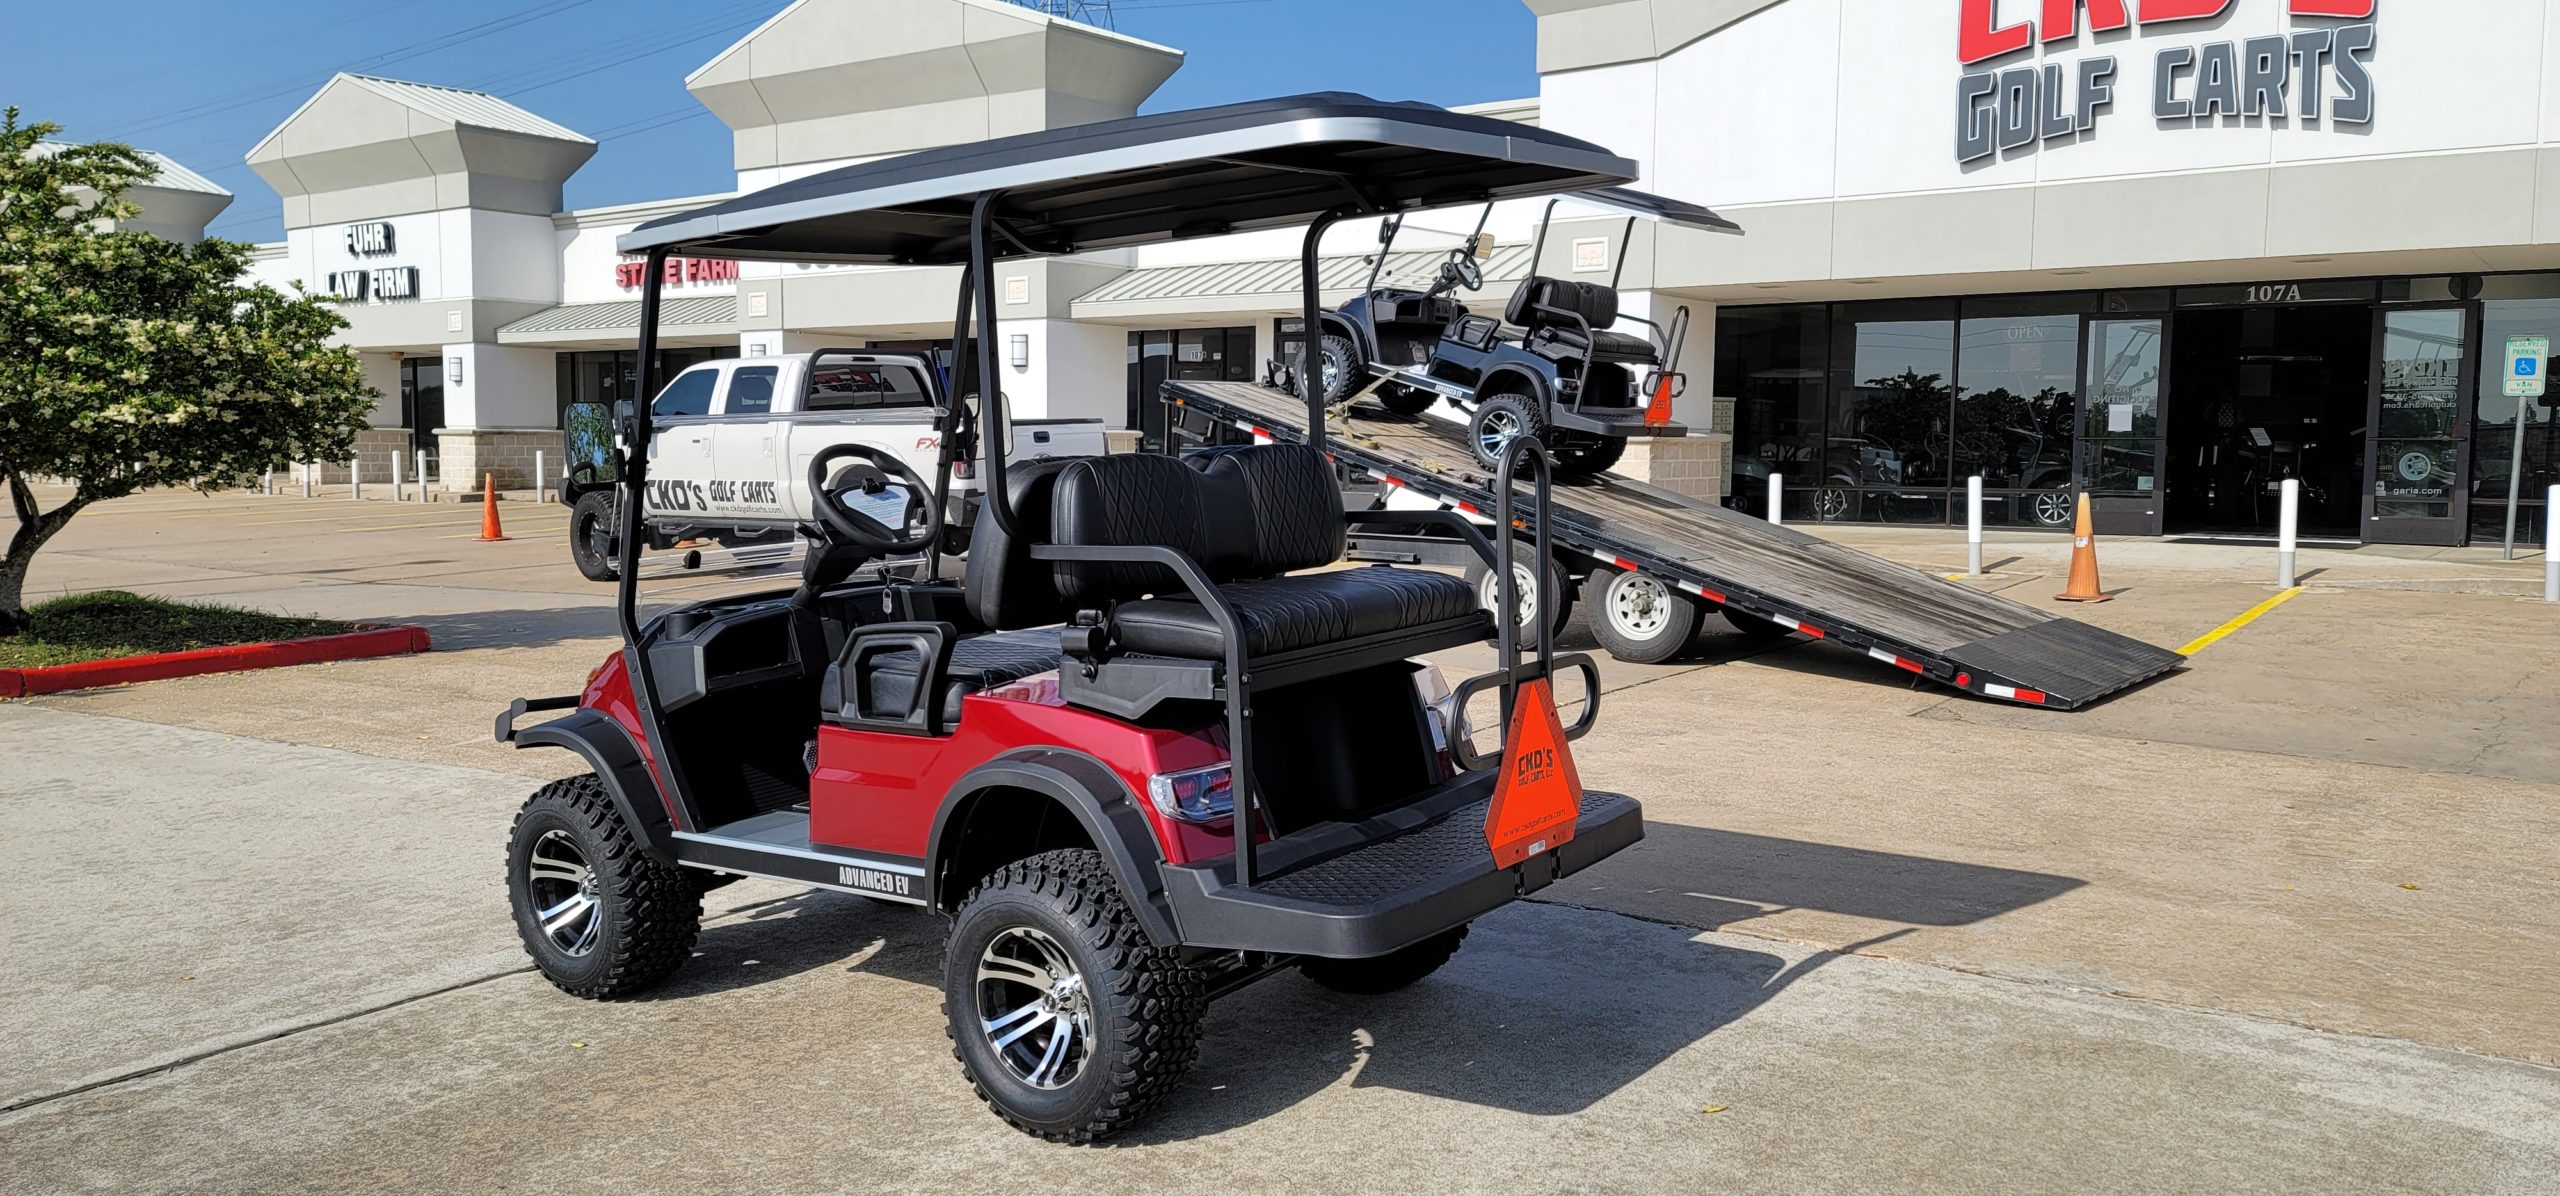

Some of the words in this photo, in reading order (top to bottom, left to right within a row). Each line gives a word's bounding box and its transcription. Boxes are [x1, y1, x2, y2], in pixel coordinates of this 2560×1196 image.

[1954, 55, 2117, 163] GOLF
[2152, 22, 2375, 124] CARTS
[343, 222, 392, 254] FUHR
[325, 270, 365, 300] LAW
[369, 267, 416, 299] FIRM
[615, 259, 684, 288] STE
[686, 257, 740, 281] FARM
[2246, 284, 2301, 302] 107A
[2007, 326, 2043, 340] OPEN
[915, 437, 942, 449] FX
[709, 480, 736, 502] GOLF
[741, 481, 777, 503] CARTS
[2393, 486, 2442, 496] garia.com
[1518, 747, 1553, 777] CKD'S
[839, 866, 894, 892] ADVANCED
[895, 875, 909, 895] EV
